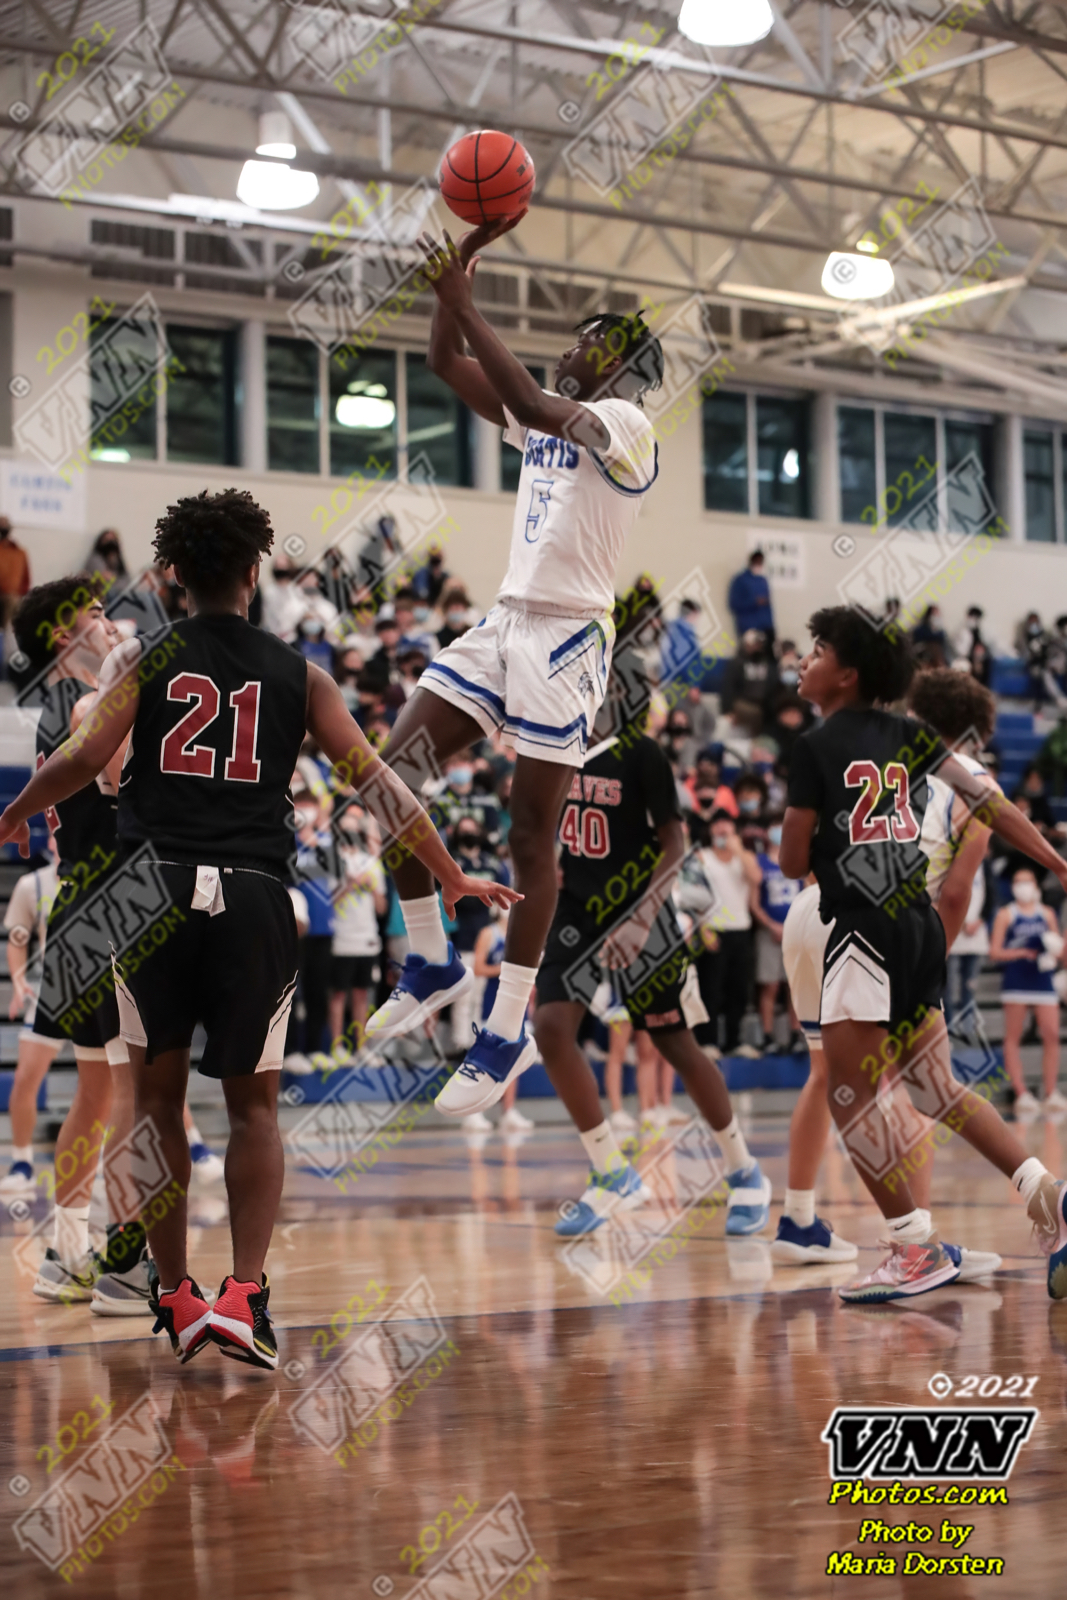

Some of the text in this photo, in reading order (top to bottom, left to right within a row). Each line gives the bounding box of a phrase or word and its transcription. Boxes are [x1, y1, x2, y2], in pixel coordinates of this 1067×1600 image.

[524, 478, 555, 544] 5
[160, 671, 262, 783] 21
[567, 773, 623, 807] AVES
[843, 760, 921, 846] 23
[559, 804, 611, 860] 40
